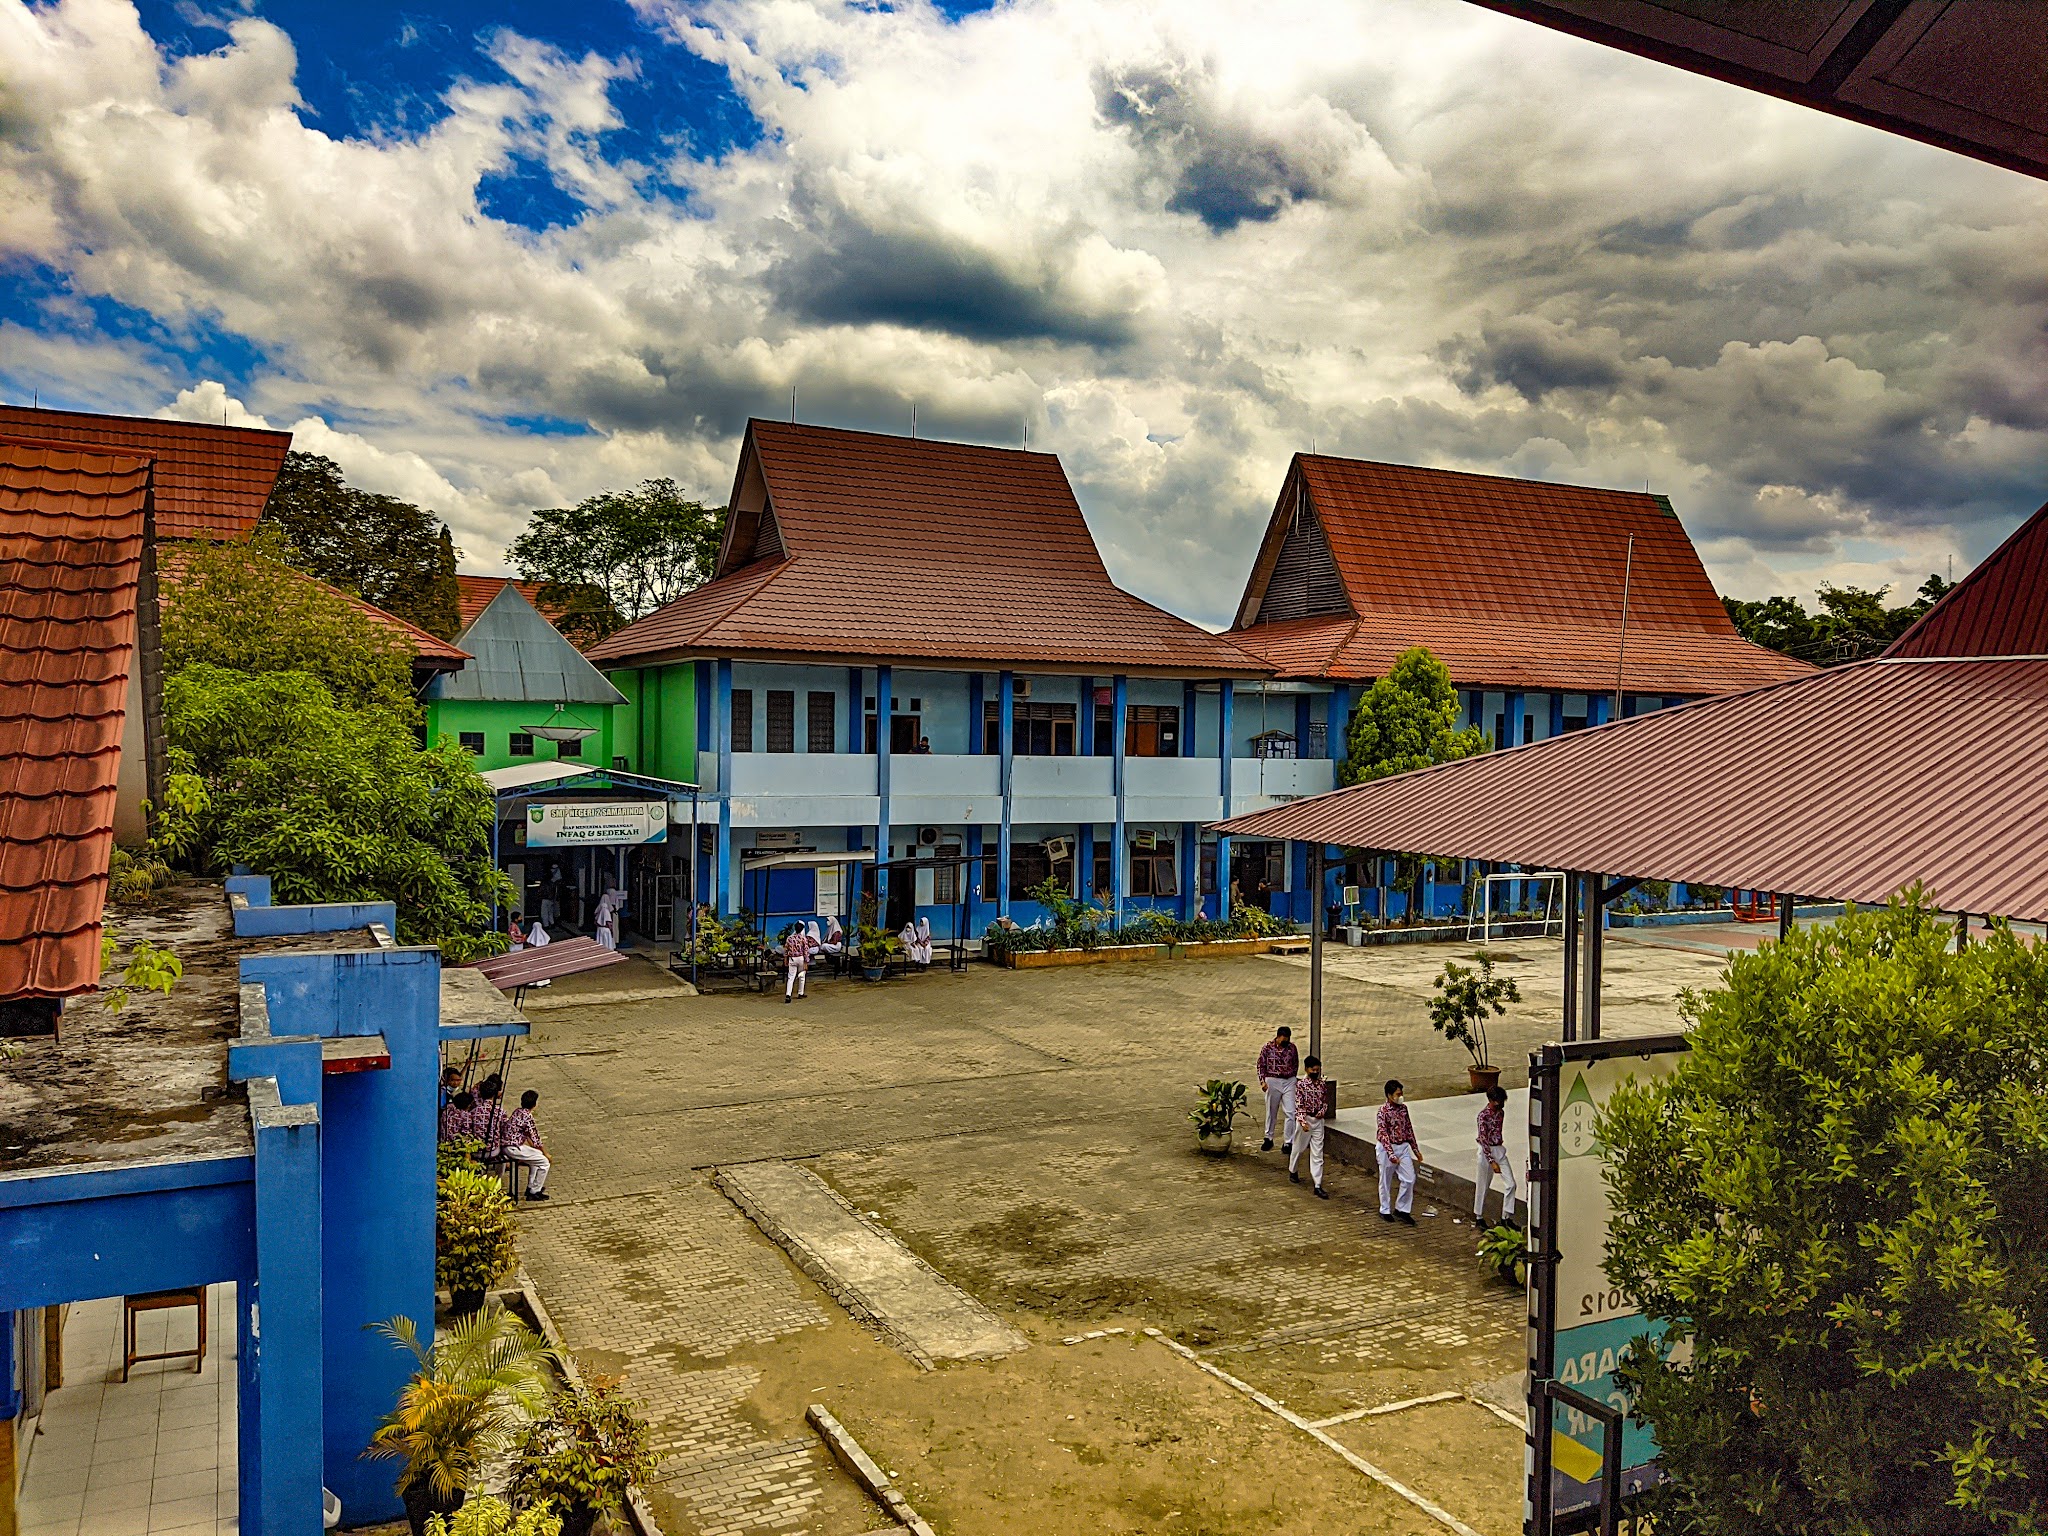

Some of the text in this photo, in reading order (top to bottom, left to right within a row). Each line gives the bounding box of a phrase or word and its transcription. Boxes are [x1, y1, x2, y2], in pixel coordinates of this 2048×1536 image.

[551, 807, 644, 818] SMP NEGERI 2 SAMARINDA
